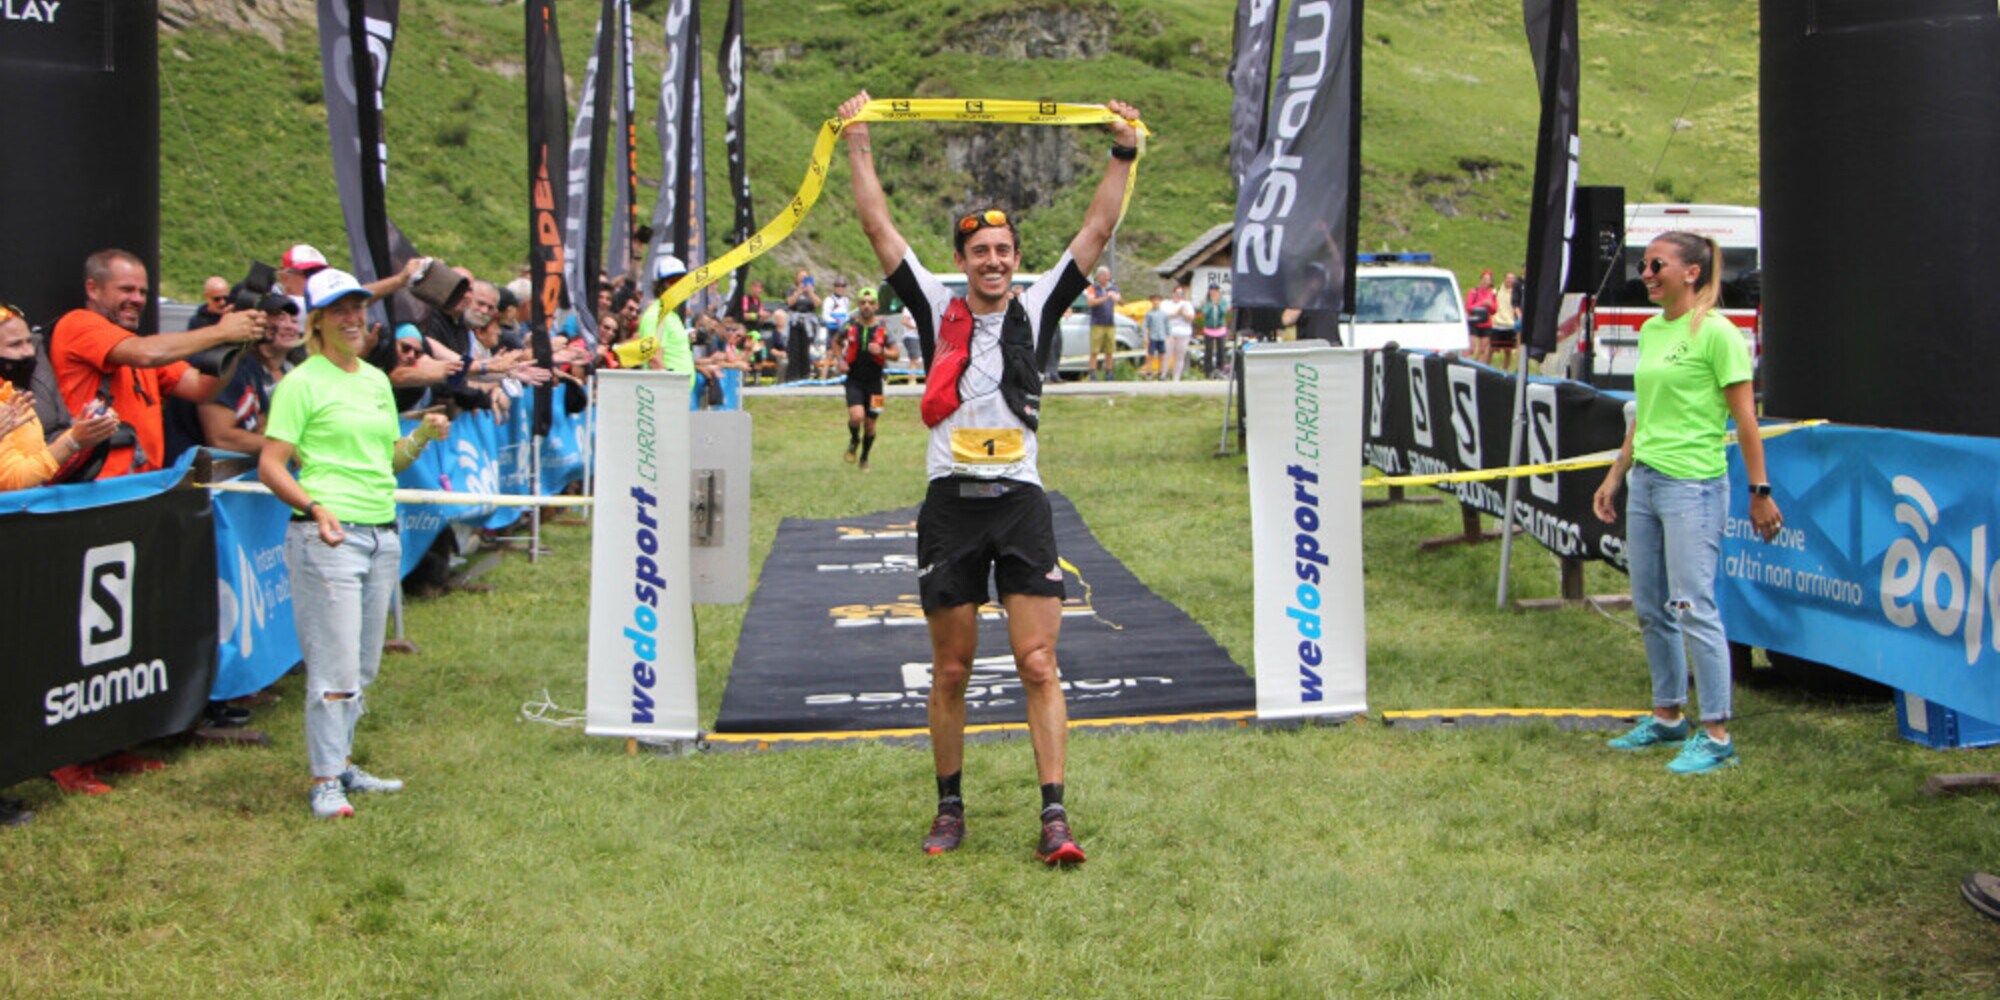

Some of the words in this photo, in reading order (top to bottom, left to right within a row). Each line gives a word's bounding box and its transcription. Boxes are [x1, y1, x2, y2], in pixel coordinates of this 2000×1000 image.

[0, 0, 60, 23] LAY
[982, 438, 996, 456] 1
[623, 486, 667, 724] wedosport
[1286, 464, 1329, 703] wedosport
[1725, 550, 1762, 582] altri
[1765, 564, 1793, 590] non
[1796, 565, 1863, 606] arrivano
